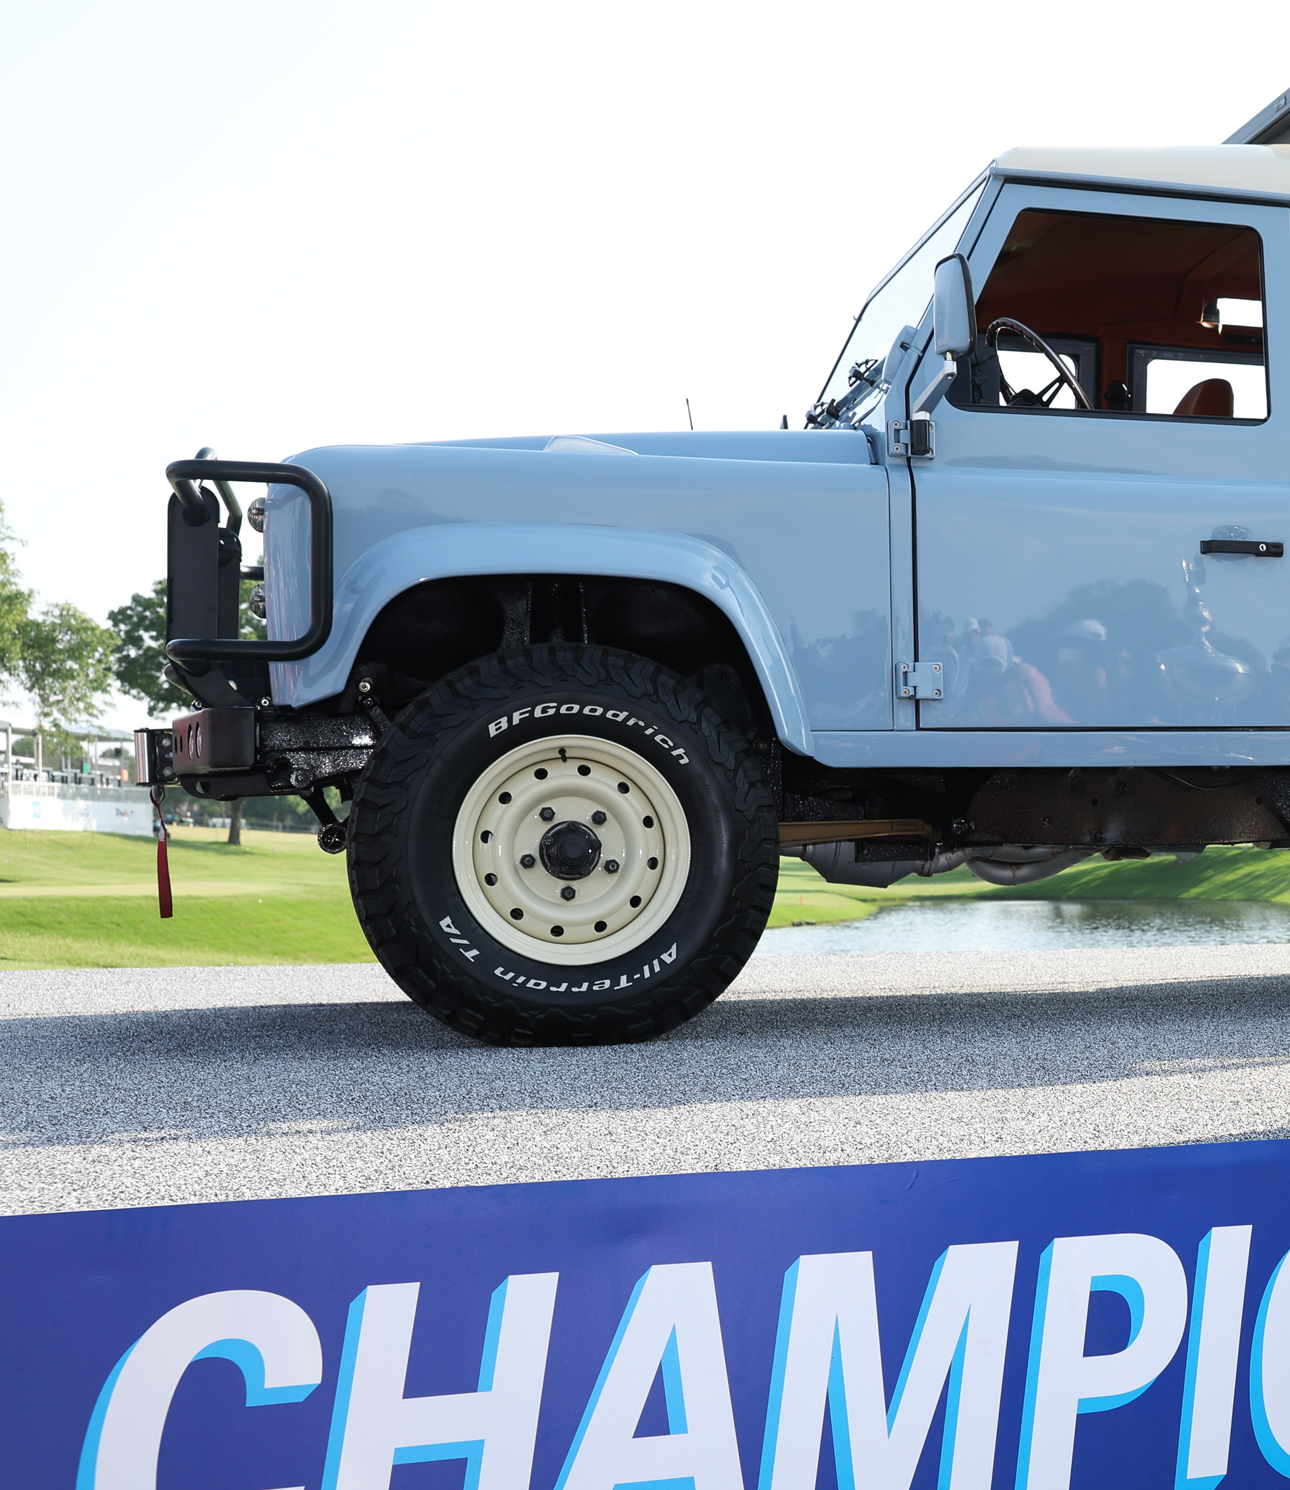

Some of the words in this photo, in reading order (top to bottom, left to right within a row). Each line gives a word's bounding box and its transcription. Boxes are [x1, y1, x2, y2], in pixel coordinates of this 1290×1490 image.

[488, 702, 690, 765] BFGoodrich
[439, 915, 480, 963] T/A
[494, 942, 677, 992] All-Terrain
